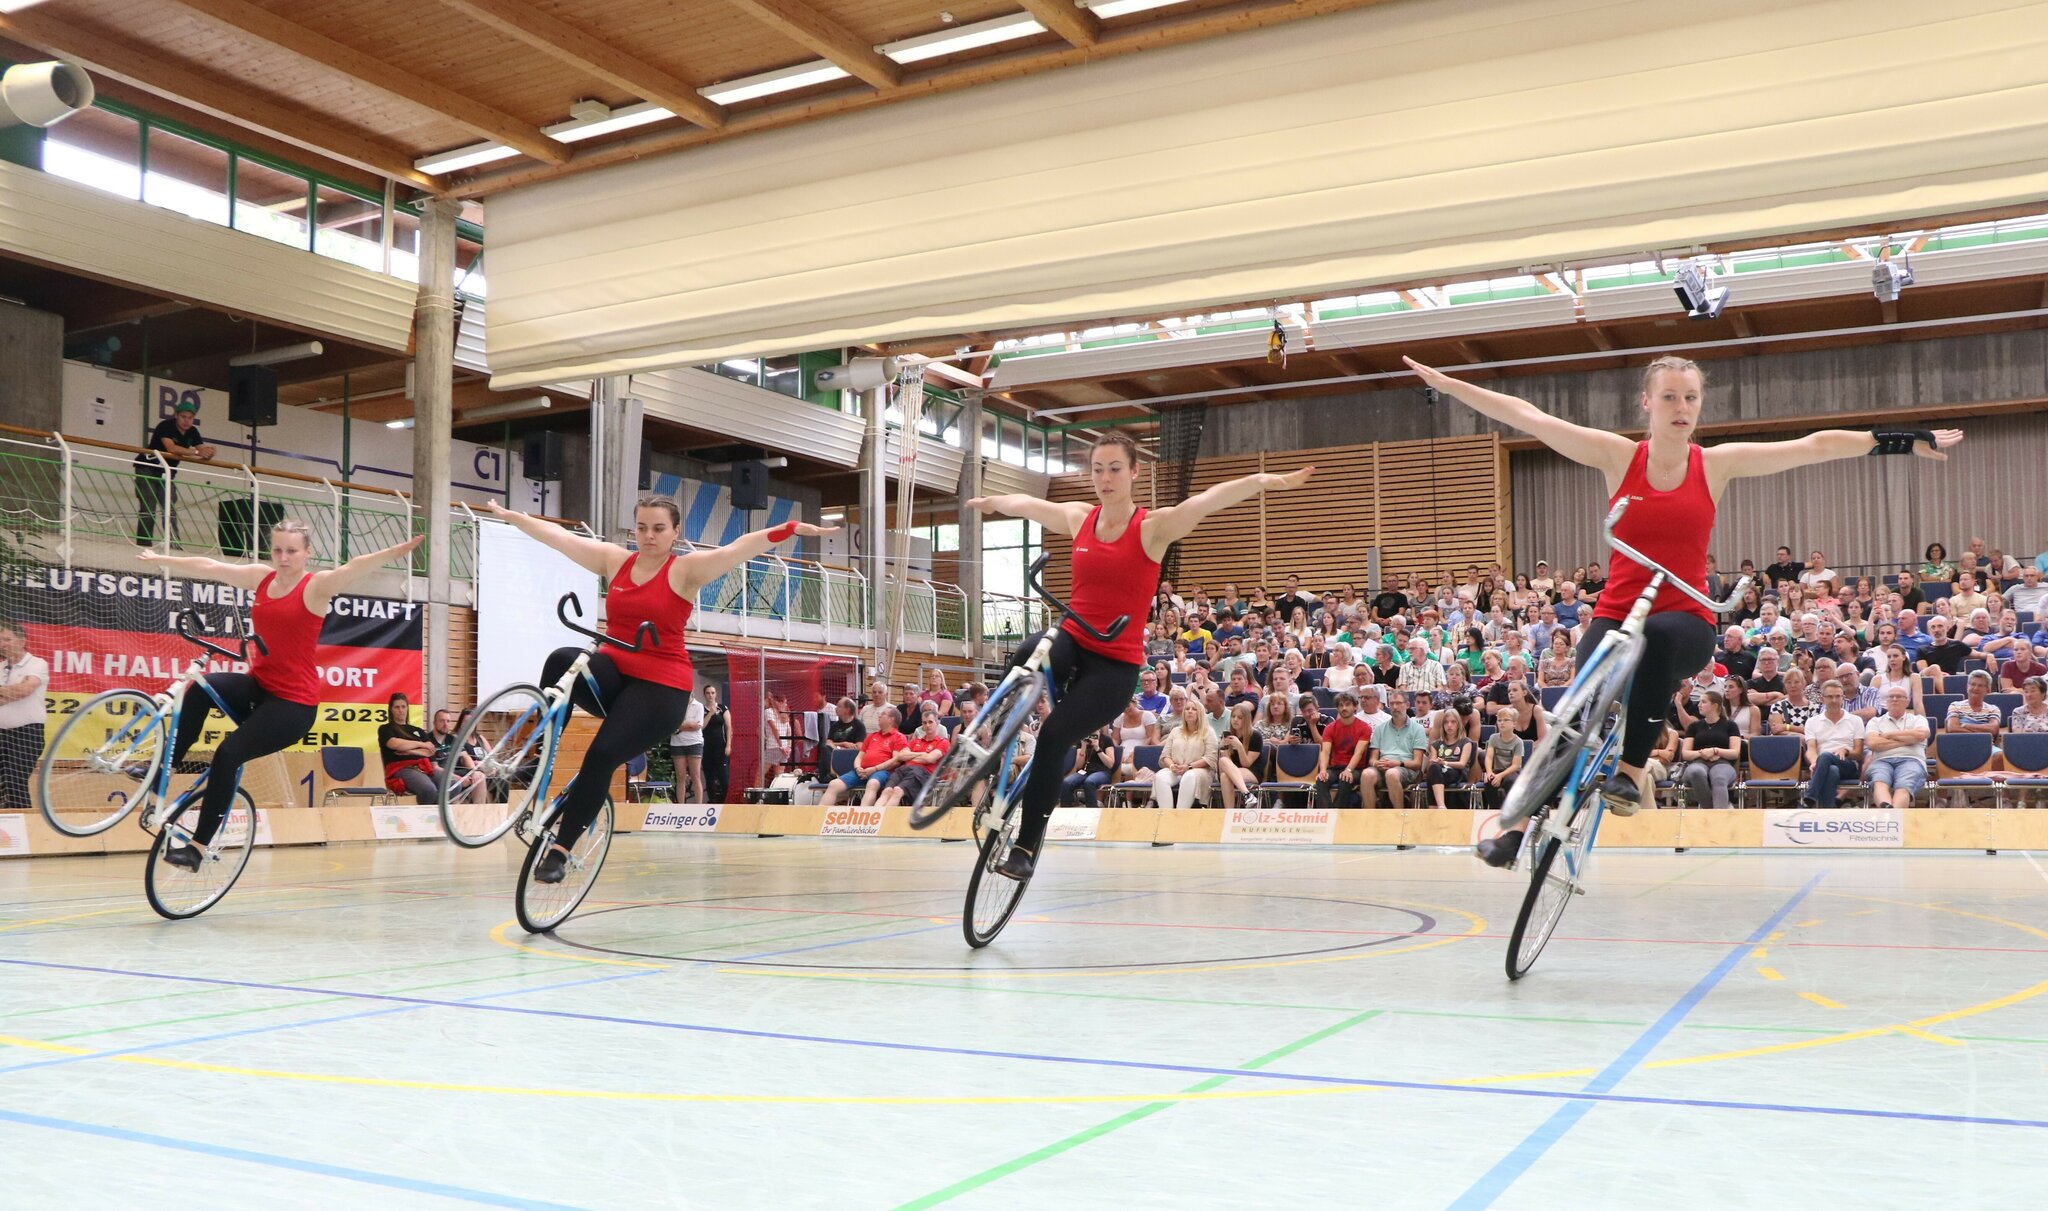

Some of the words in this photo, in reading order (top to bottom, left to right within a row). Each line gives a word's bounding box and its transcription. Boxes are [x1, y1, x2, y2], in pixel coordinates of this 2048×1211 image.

[474, 450, 500, 481] C1
[53, 650, 93, 674] IM
[105, 700, 173, 718] UN
[324, 708, 388, 722] 2023
[645, 812, 697, 829] Ensinger
[825, 807, 881, 825] sehne
[1799, 821, 1899, 833] ELSÄSSER
